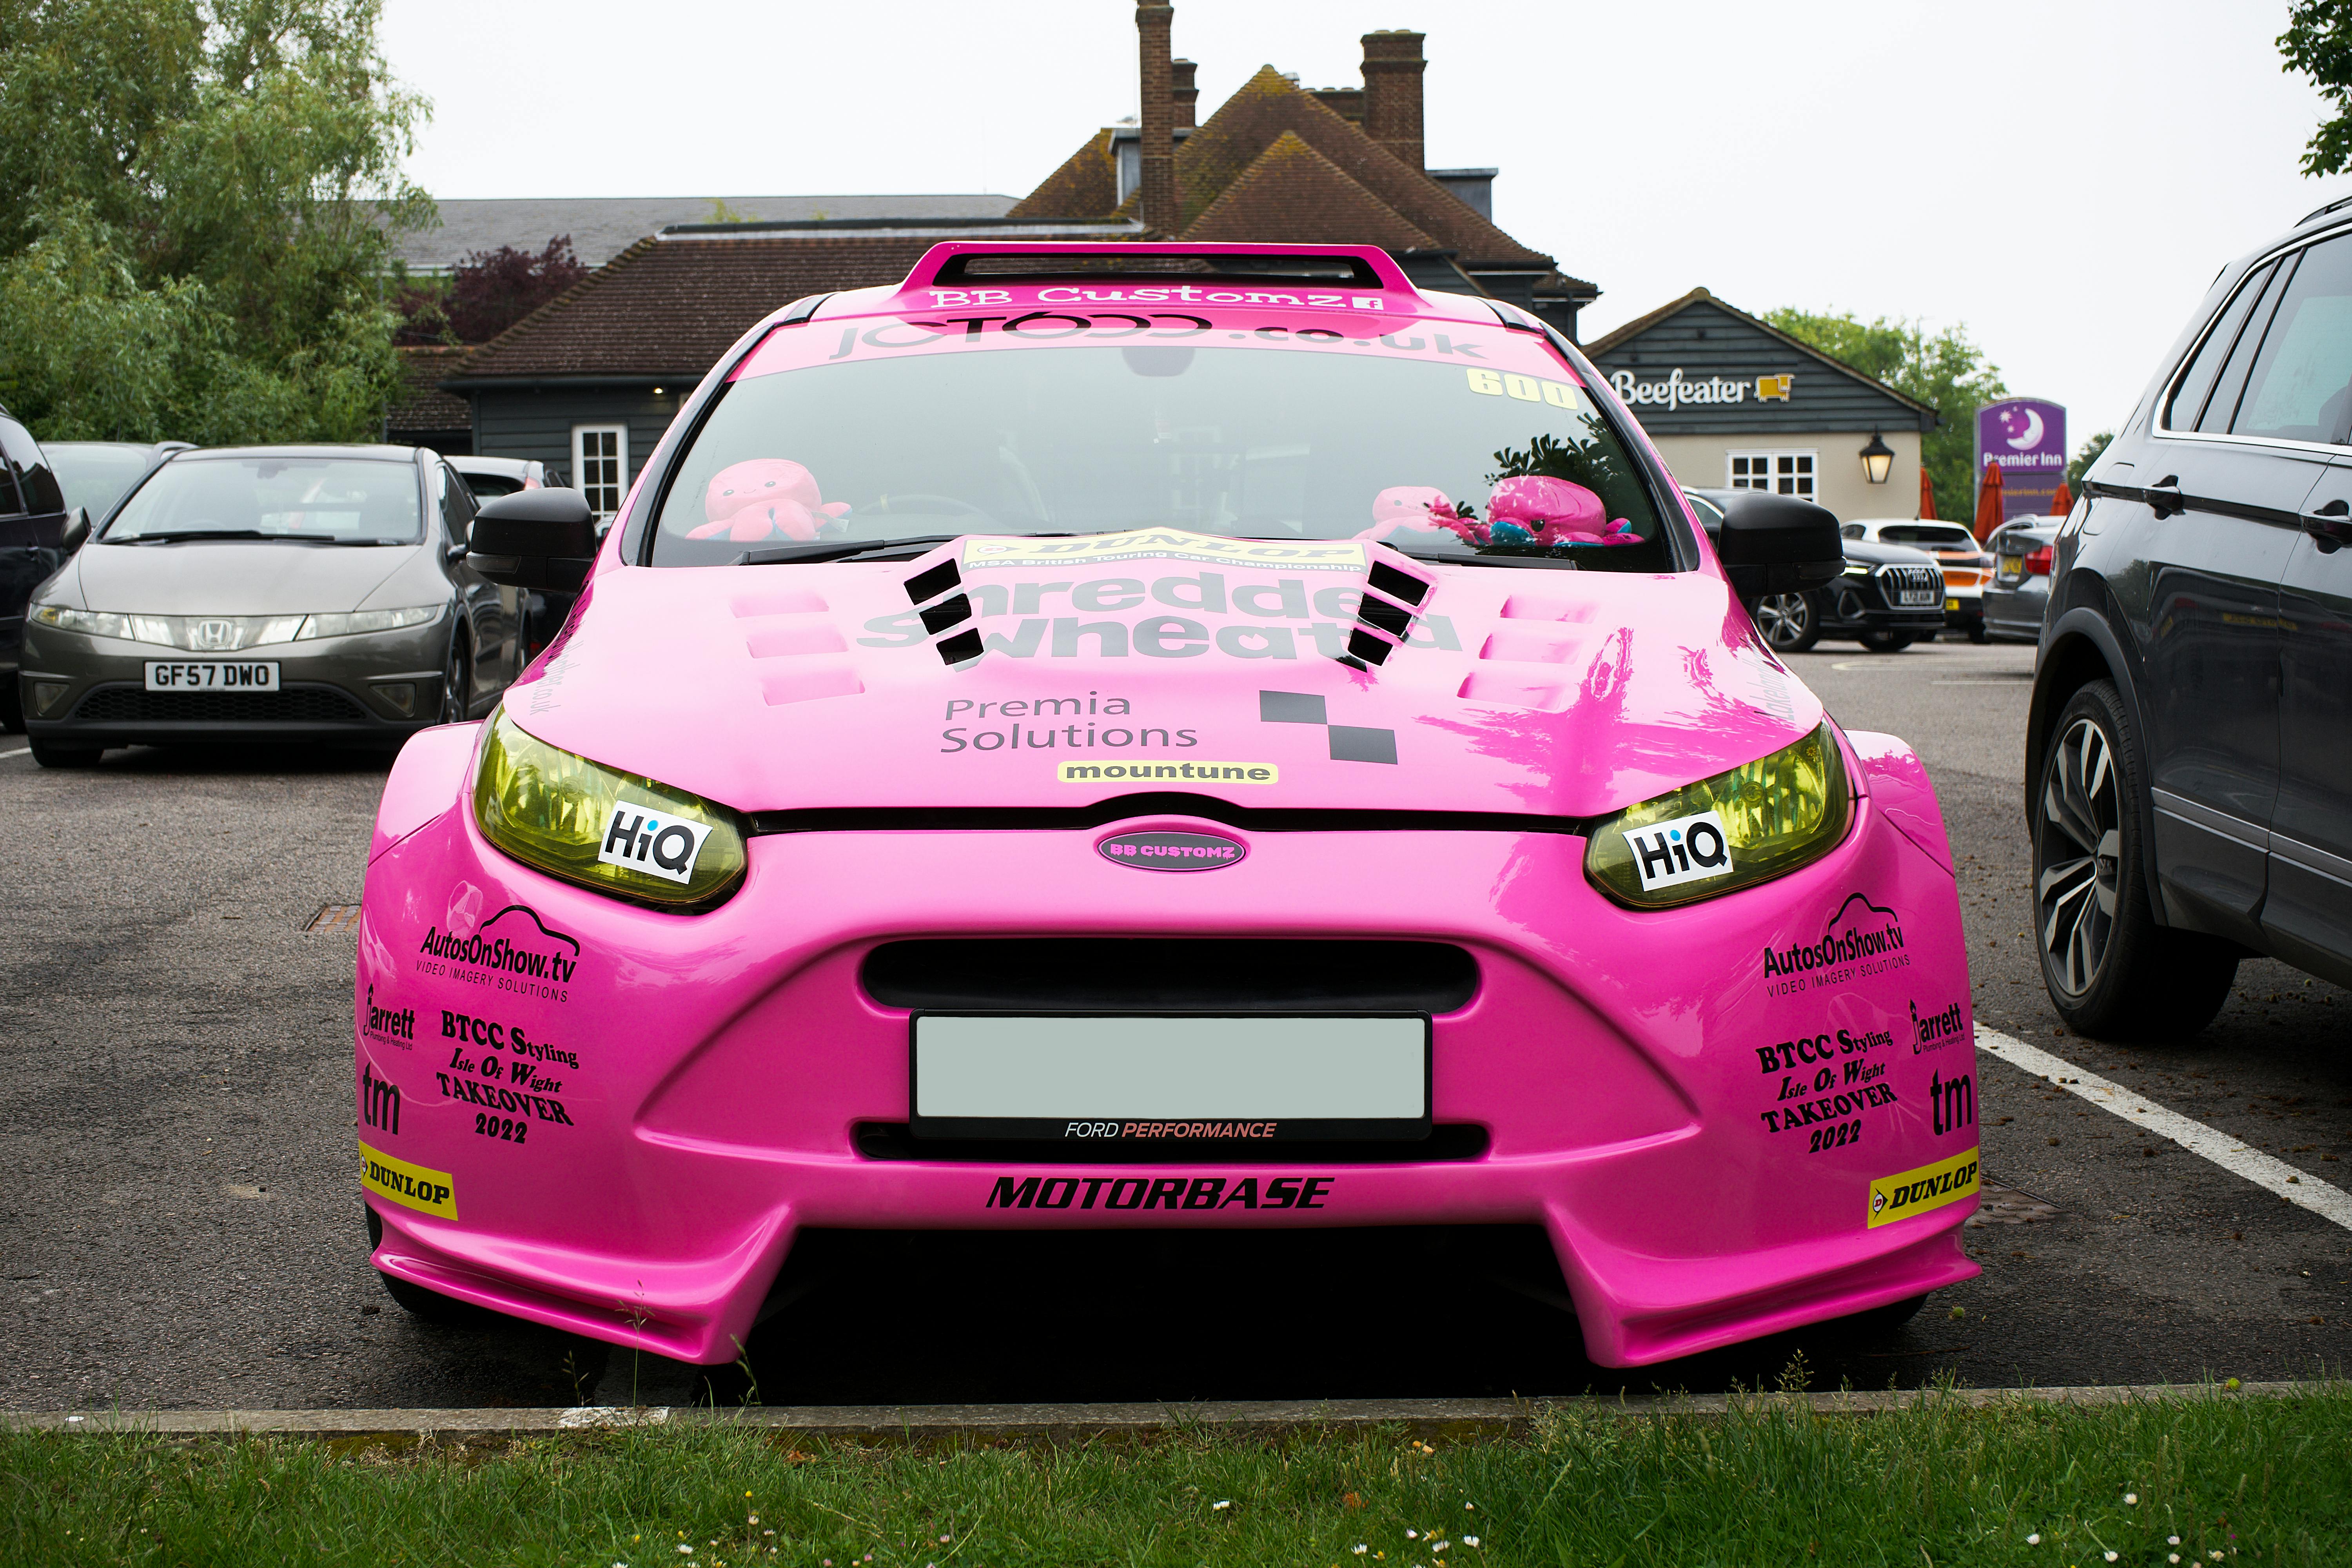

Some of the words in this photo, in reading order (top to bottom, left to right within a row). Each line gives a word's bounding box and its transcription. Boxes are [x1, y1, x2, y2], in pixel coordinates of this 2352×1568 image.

[929, 290, 1013, 308] BB
[1038, 286, 1347, 308] Customz
[1466, 368, 1578, 410] 600
[1610, 368, 1752, 412] Beefeater
[2041, 451, 2062, 466] Inn
[969, 559, 1016, 568] MSA
[1022, 557, 1086, 566] British
[1093, 551, 1167, 562] Touring
[1174, 553, 1210, 562] Car
[1216, 557, 1362, 572] Championship
[1027, 534, 1355, 558] DUNLOP
[155, 665, 216, 686] GF57
[223, 665, 269, 686] DWO
[946, 691, 1131, 720] Premia
[941, 722, 1198, 753] Solutions
[1066, 762, 1271, 781] mountune
[605, 810, 695, 875] HiQ
[1110, 844, 1137, 857] BB
[1140, 846, 1235, 860] CUSTOMZ
[1633, 822, 1728, 879] HiQ
[420, 926, 577, 983] AutosOnShow.tv
[1764, 922, 1904, 978] AutosOnShow.tv
[416, 960, 446, 976] VIDEO
[449, 967, 494, 986] IMAGERY
[497, 977, 568, 1002] SOLUTIONS
[1767, 979, 1806, 997] VIDEO
[1811, 967, 1856, 988] IMAGERY
[1860, 954, 1910, 977] SOLUTIONS
[370, 1031, 386, 1045] Plumbing
[387, 1036, 390, 1044] &
[390, 1037, 405, 1050] Heating
[441, 1009, 505, 1050] BTCC
[510, 1027, 579, 1069] Styling
[1755, 1034, 1834, 1074] BTCC
[1837, 1029, 1893, 1054] Styling
[1923, 1042, 1942, 1053] Plumbing
[1942, 1039, 1945, 1047] &
[449, 1047, 475, 1073] Isle
[481, 1056, 504, 1079] Of
[511, 1062, 563, 1093] Wight
[1777, 1076, 1808, 1101] Isle
[1813, 1067, 1837, 1092] Of
[1843, 1058, 1886, 1085] Wight
[363, 1061, 400, 1135] tm
[436, 1072, 575, 1126] TAKEOVER
[1760, 1083, 1898, 1133] TAKEOVER
[1930, 1068, 1972, 1136] tm
[475, 1112, 528, 1144] 2022
[1064, 1122, 1119, 1137] FORD
[1121, 1122, 1277, 1137] PERFORMANCE
[1808, 1119, 1861, 1154] 2022
[370, 1160, 450, 1205] DUNLOP
[985, 1176, 1335, 1209] MOTORBASE
[1889, 1161, 1977, 1210] DUNLOP
